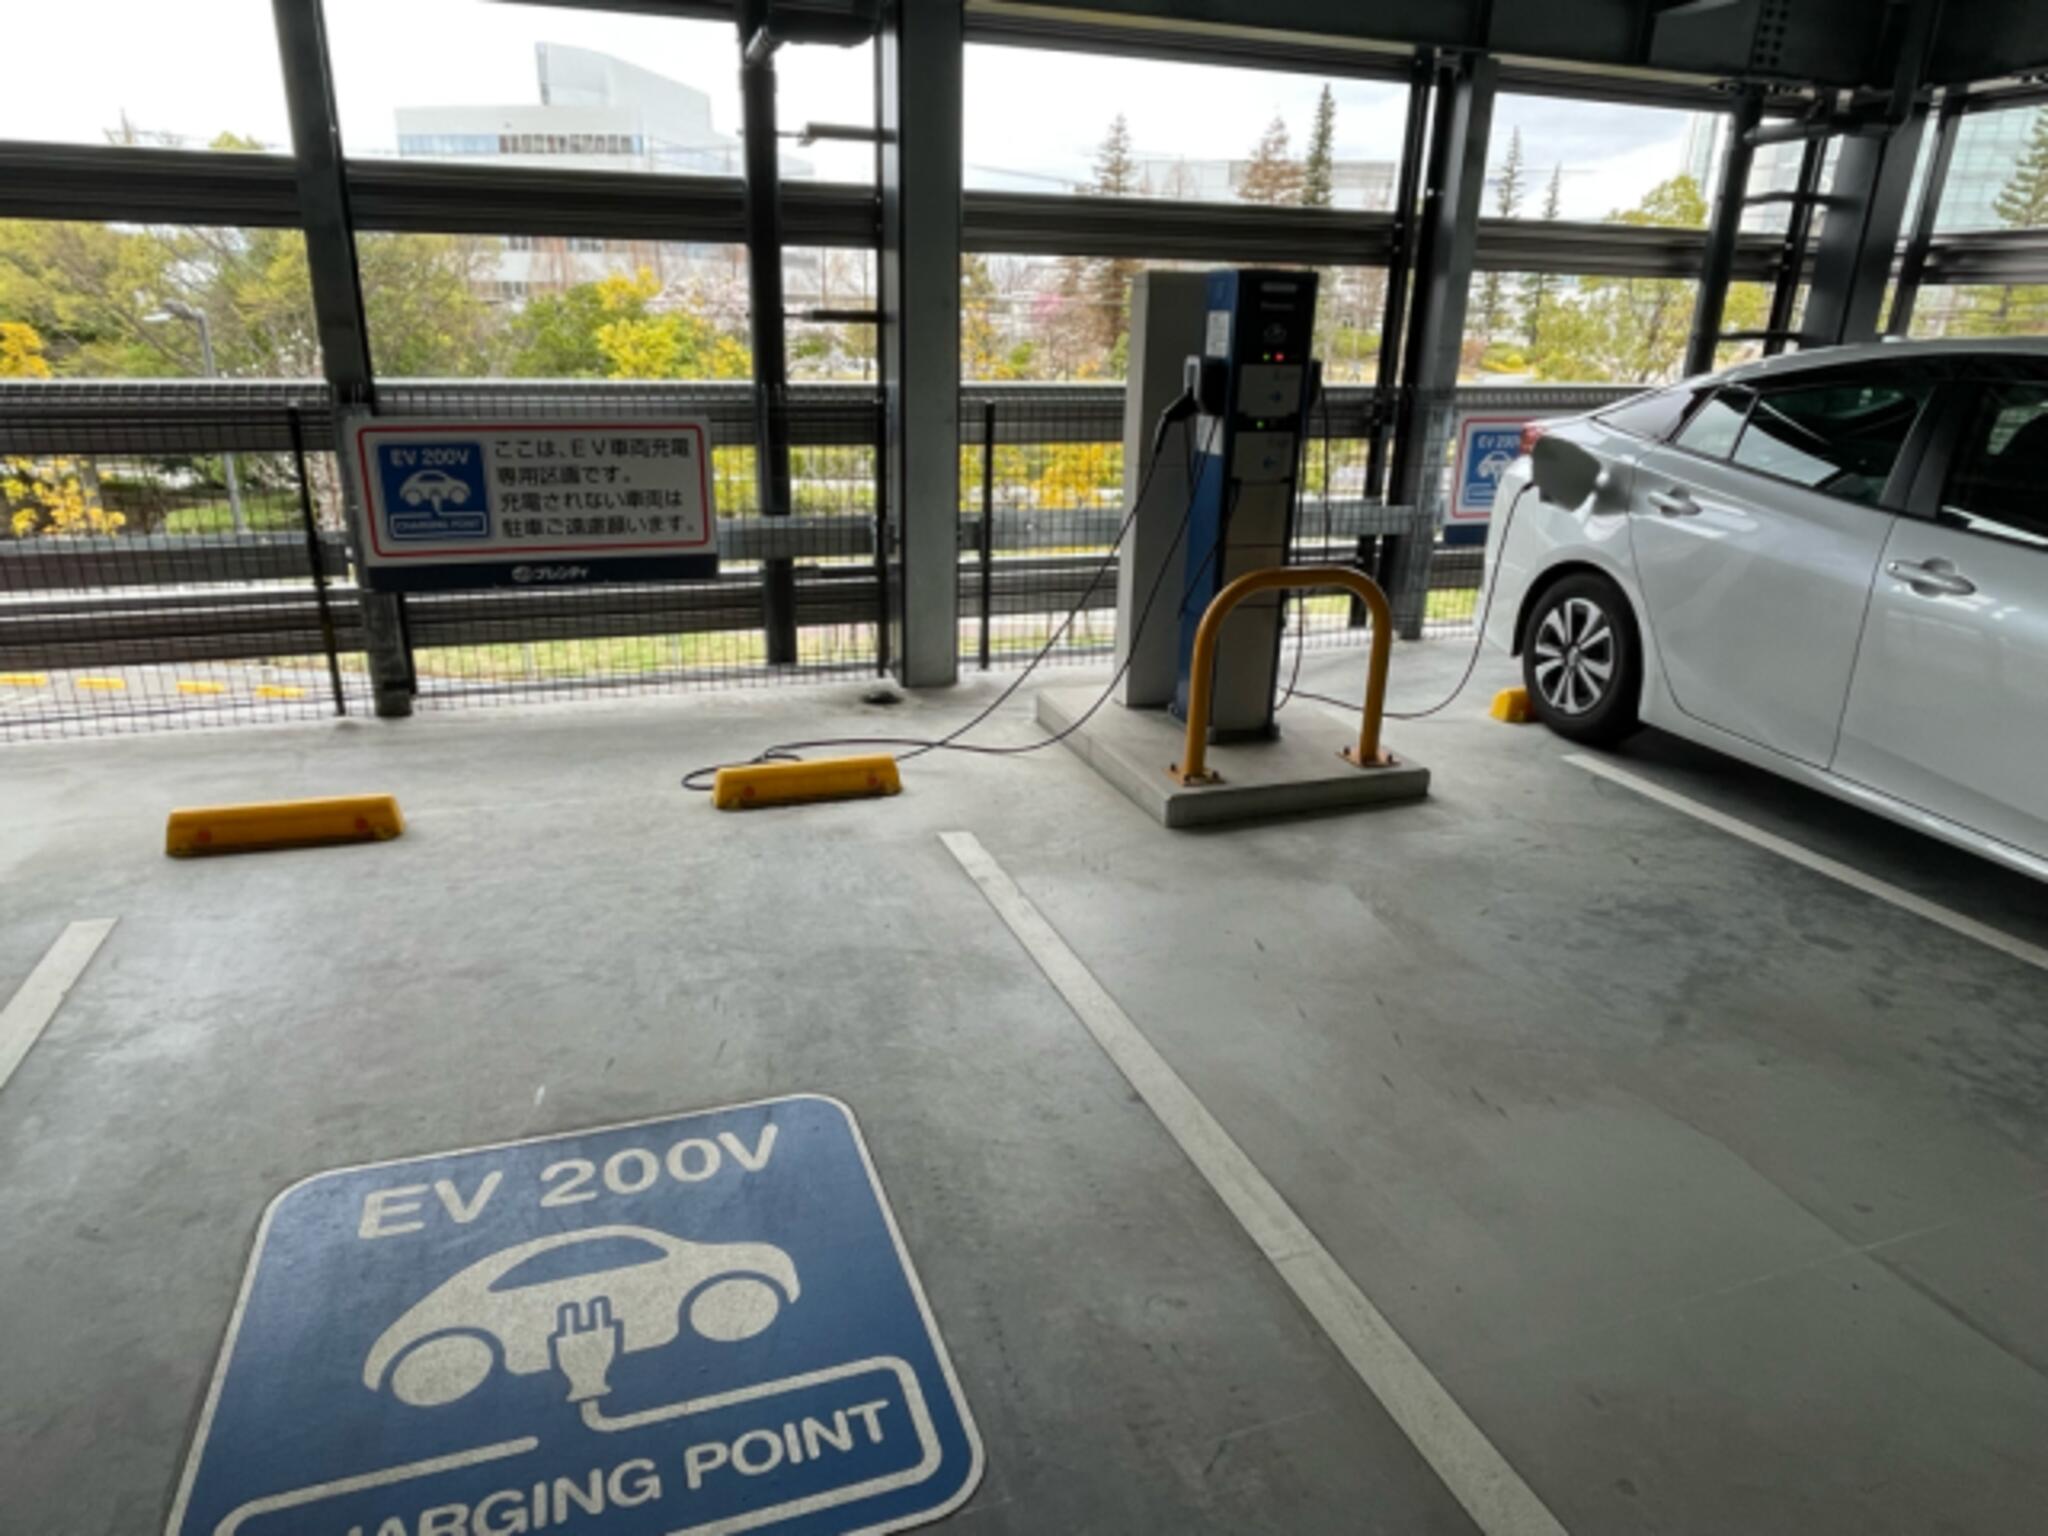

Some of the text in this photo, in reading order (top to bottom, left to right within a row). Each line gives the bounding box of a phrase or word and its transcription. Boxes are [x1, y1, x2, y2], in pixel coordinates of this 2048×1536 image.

[390, 447, 470, 466] EV 200V
[496, 465, 631, 487] 専用区画です。
[501, 489, 682, 512] 充電されない車両は
[502, 514, 694, 538] 駐車ご遠慮願います。
[357, 1122, 780, 1241] EV 200V
[686, 1400, 890, 1492] POINT
